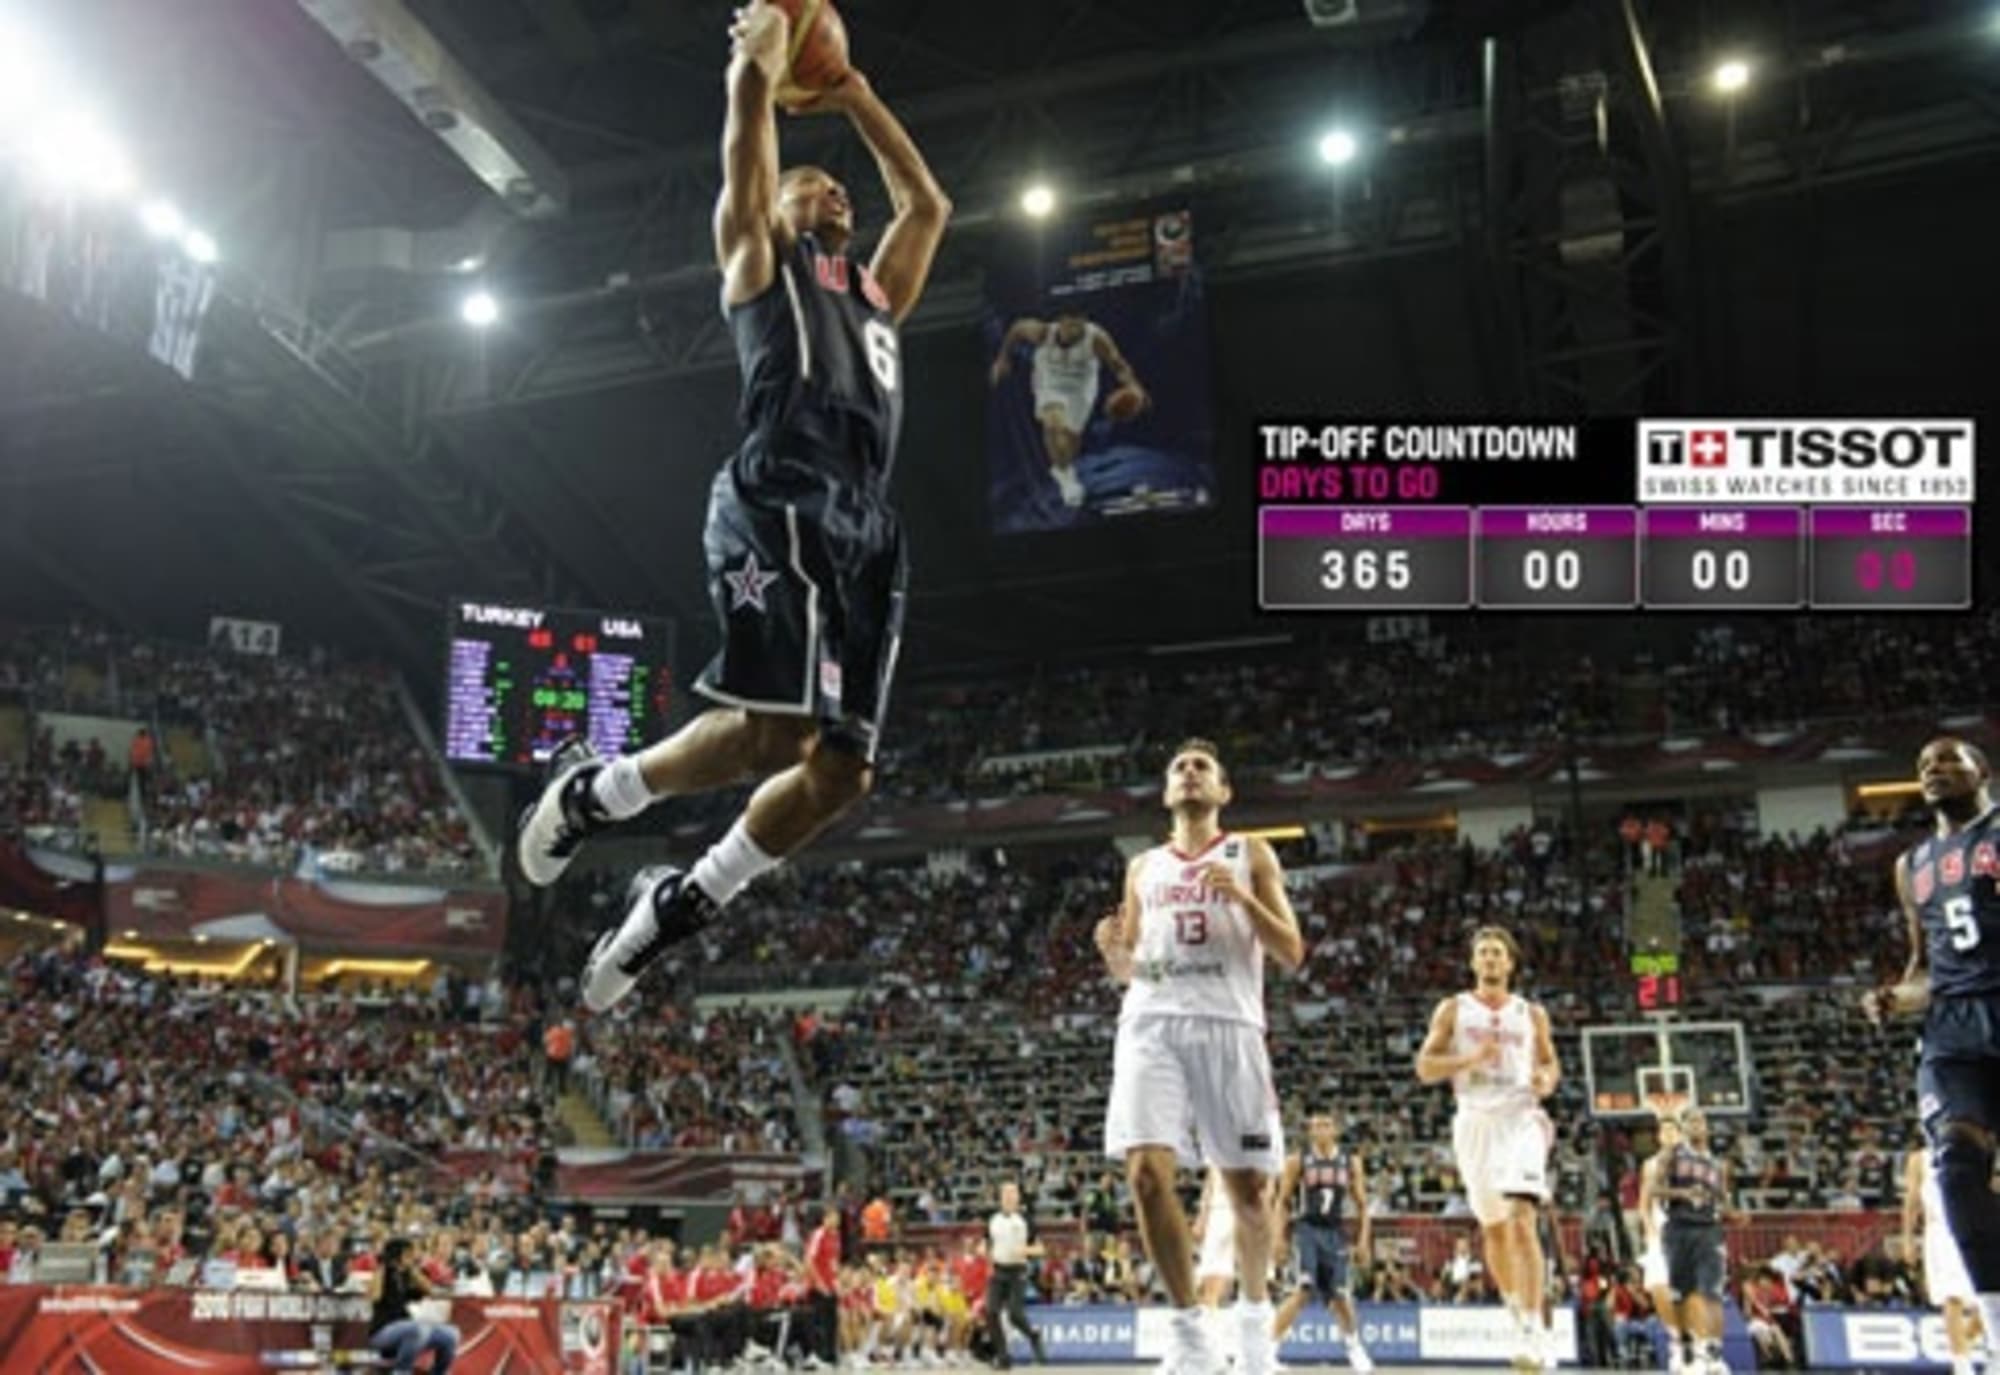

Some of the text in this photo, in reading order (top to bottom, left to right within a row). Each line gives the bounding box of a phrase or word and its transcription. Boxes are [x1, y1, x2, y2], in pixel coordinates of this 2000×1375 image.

[863, 319, 896, 391] 6
[462, 604, 545, 628] TURKEY
[602, 618, 643, 638] USA
[1174, 910, 1207, 945] 13
[1945, 895, 1980, 951] 5
